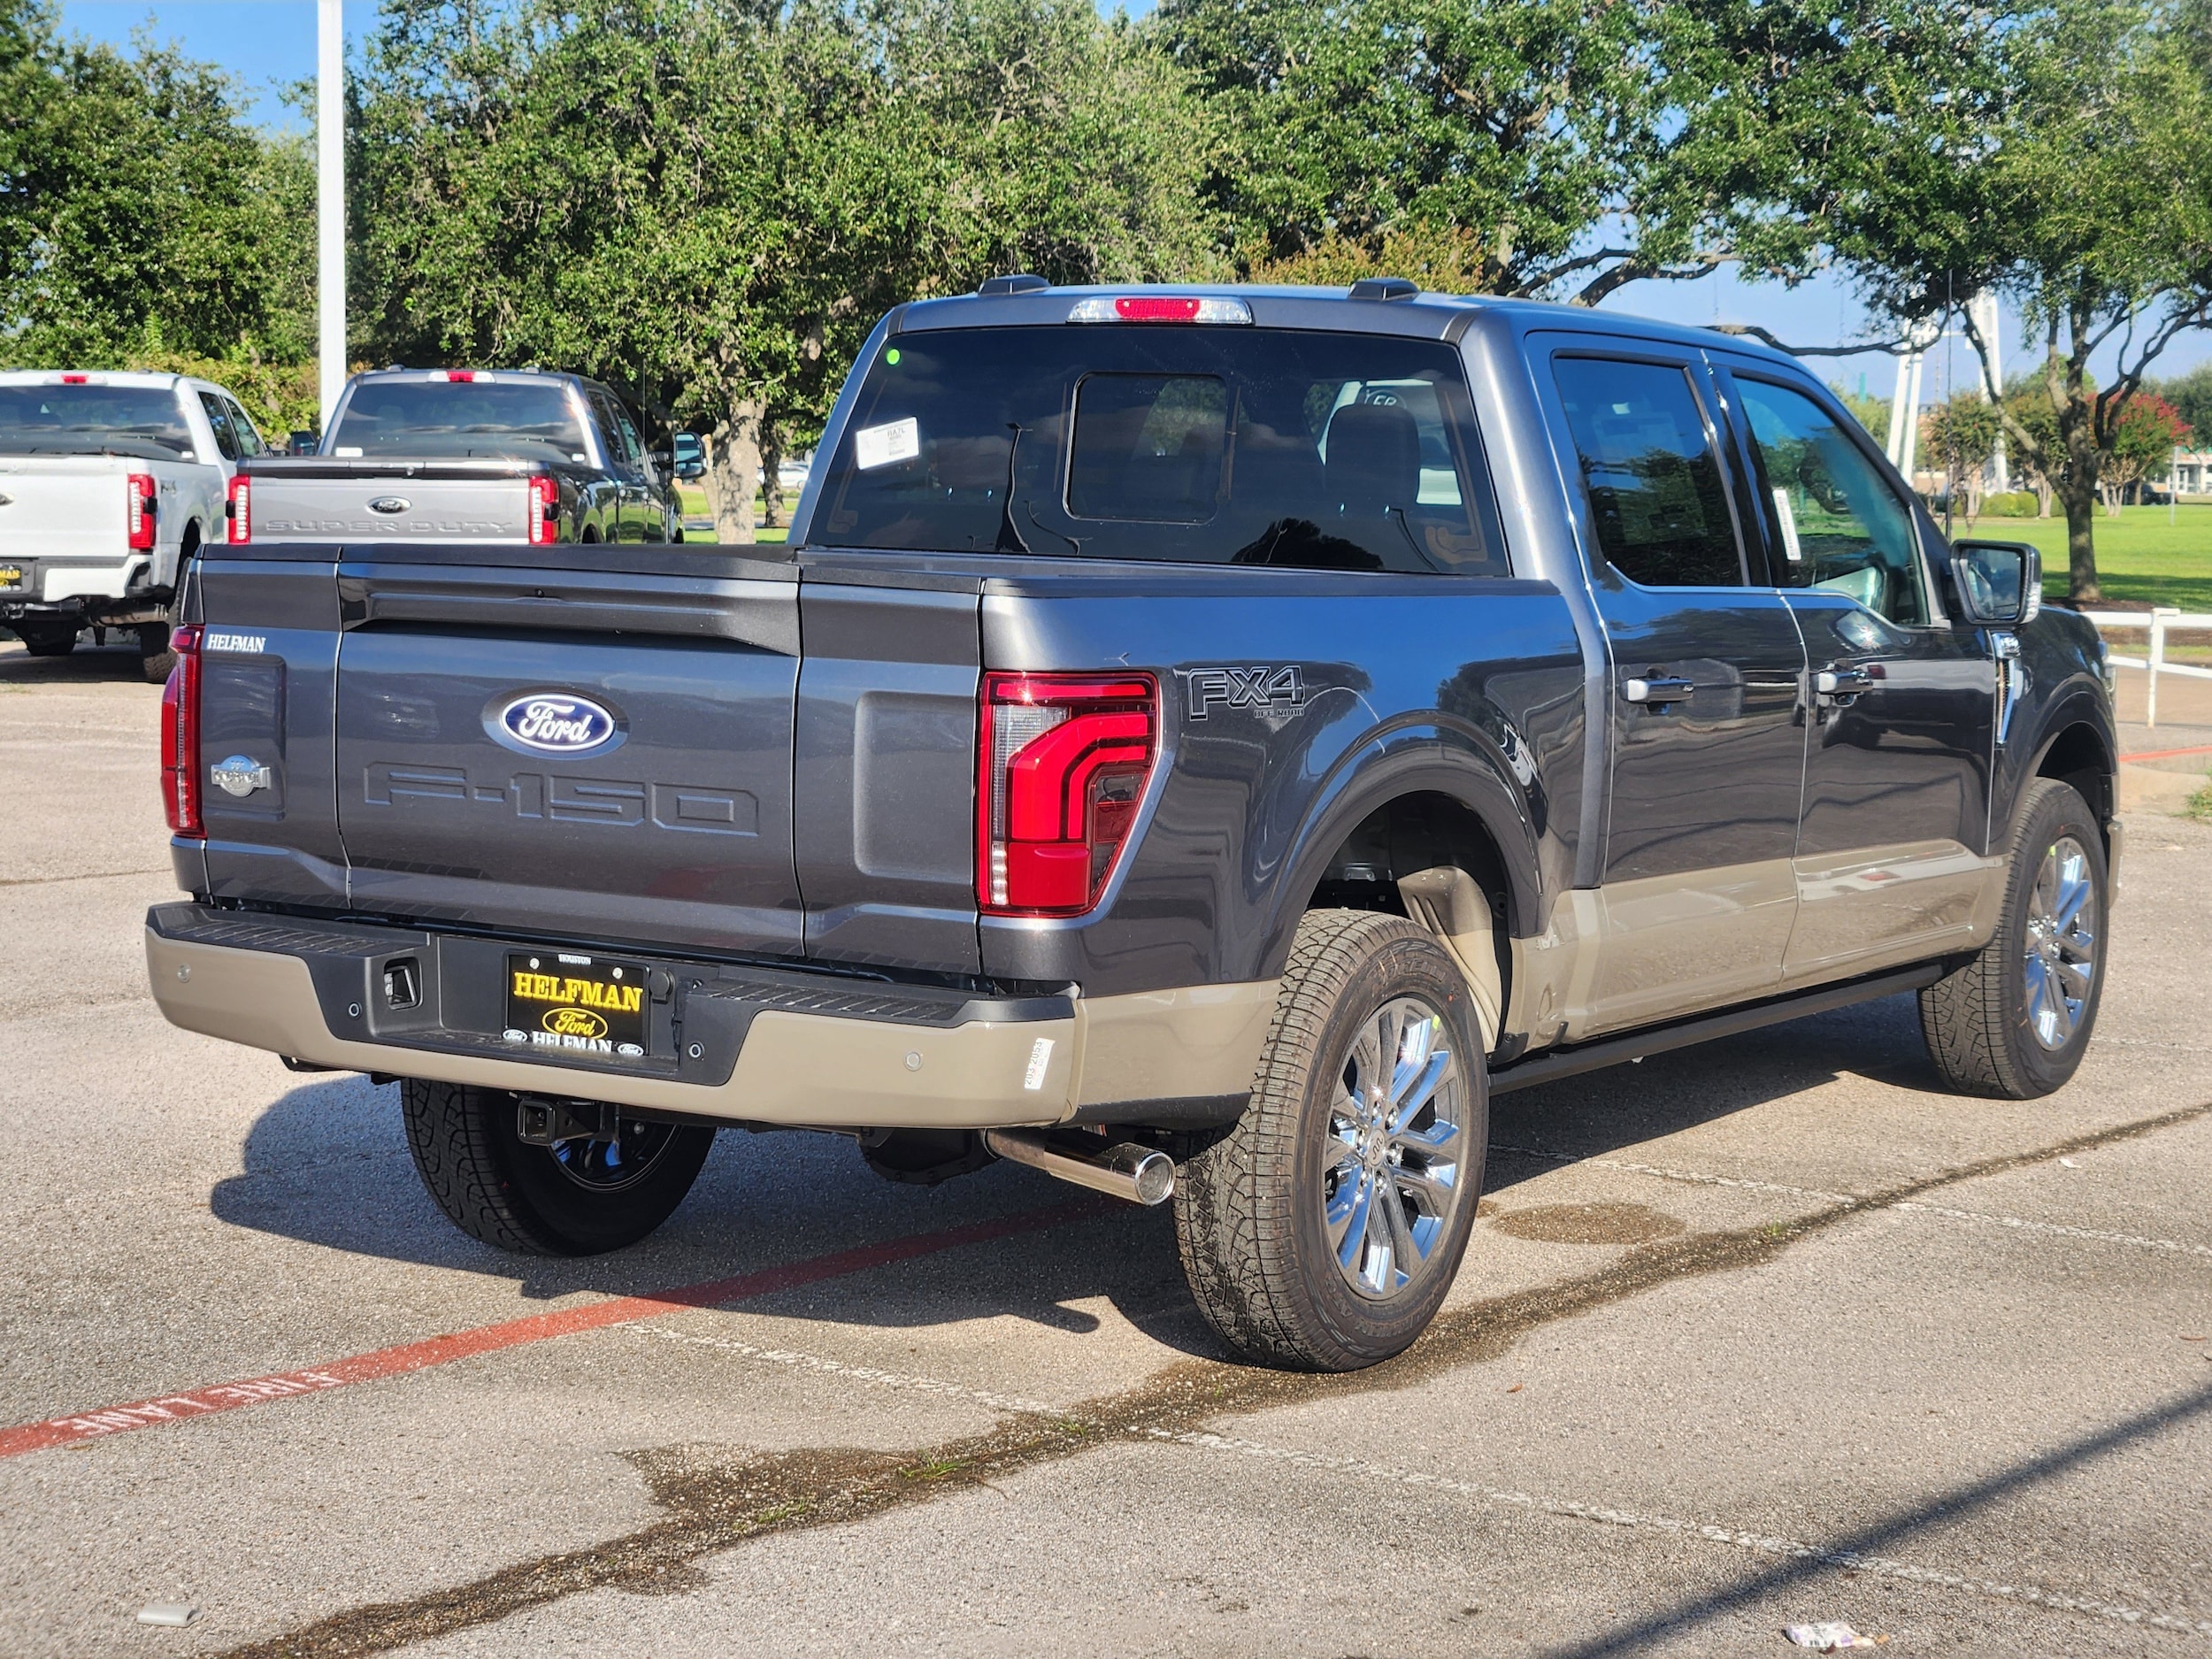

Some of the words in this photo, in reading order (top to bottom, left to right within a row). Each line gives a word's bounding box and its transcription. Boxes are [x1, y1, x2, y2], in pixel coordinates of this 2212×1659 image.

[266, 519, 399, 532] SUPER
[410, 519, 512, 533] DUTY
[207, 634, 265, 654] HELFMAN
[1188, 665, 1305, 721] FX4
[518, 700, 594, 742] Ford
[1254, 709, 1274, 718] OFF
[364, 761, 759, 837] F-150
[558, 954, 592, 965] HOUSTON
[513, 972, 644, 1012] HELFMAN
[554, 1010, 596, 1037] Ford
[532, 1031, 612, 1053] HELFMAN
[207, 1371, 344, 1402] FIRE
[50, 1397, 213, 1434] LANE
